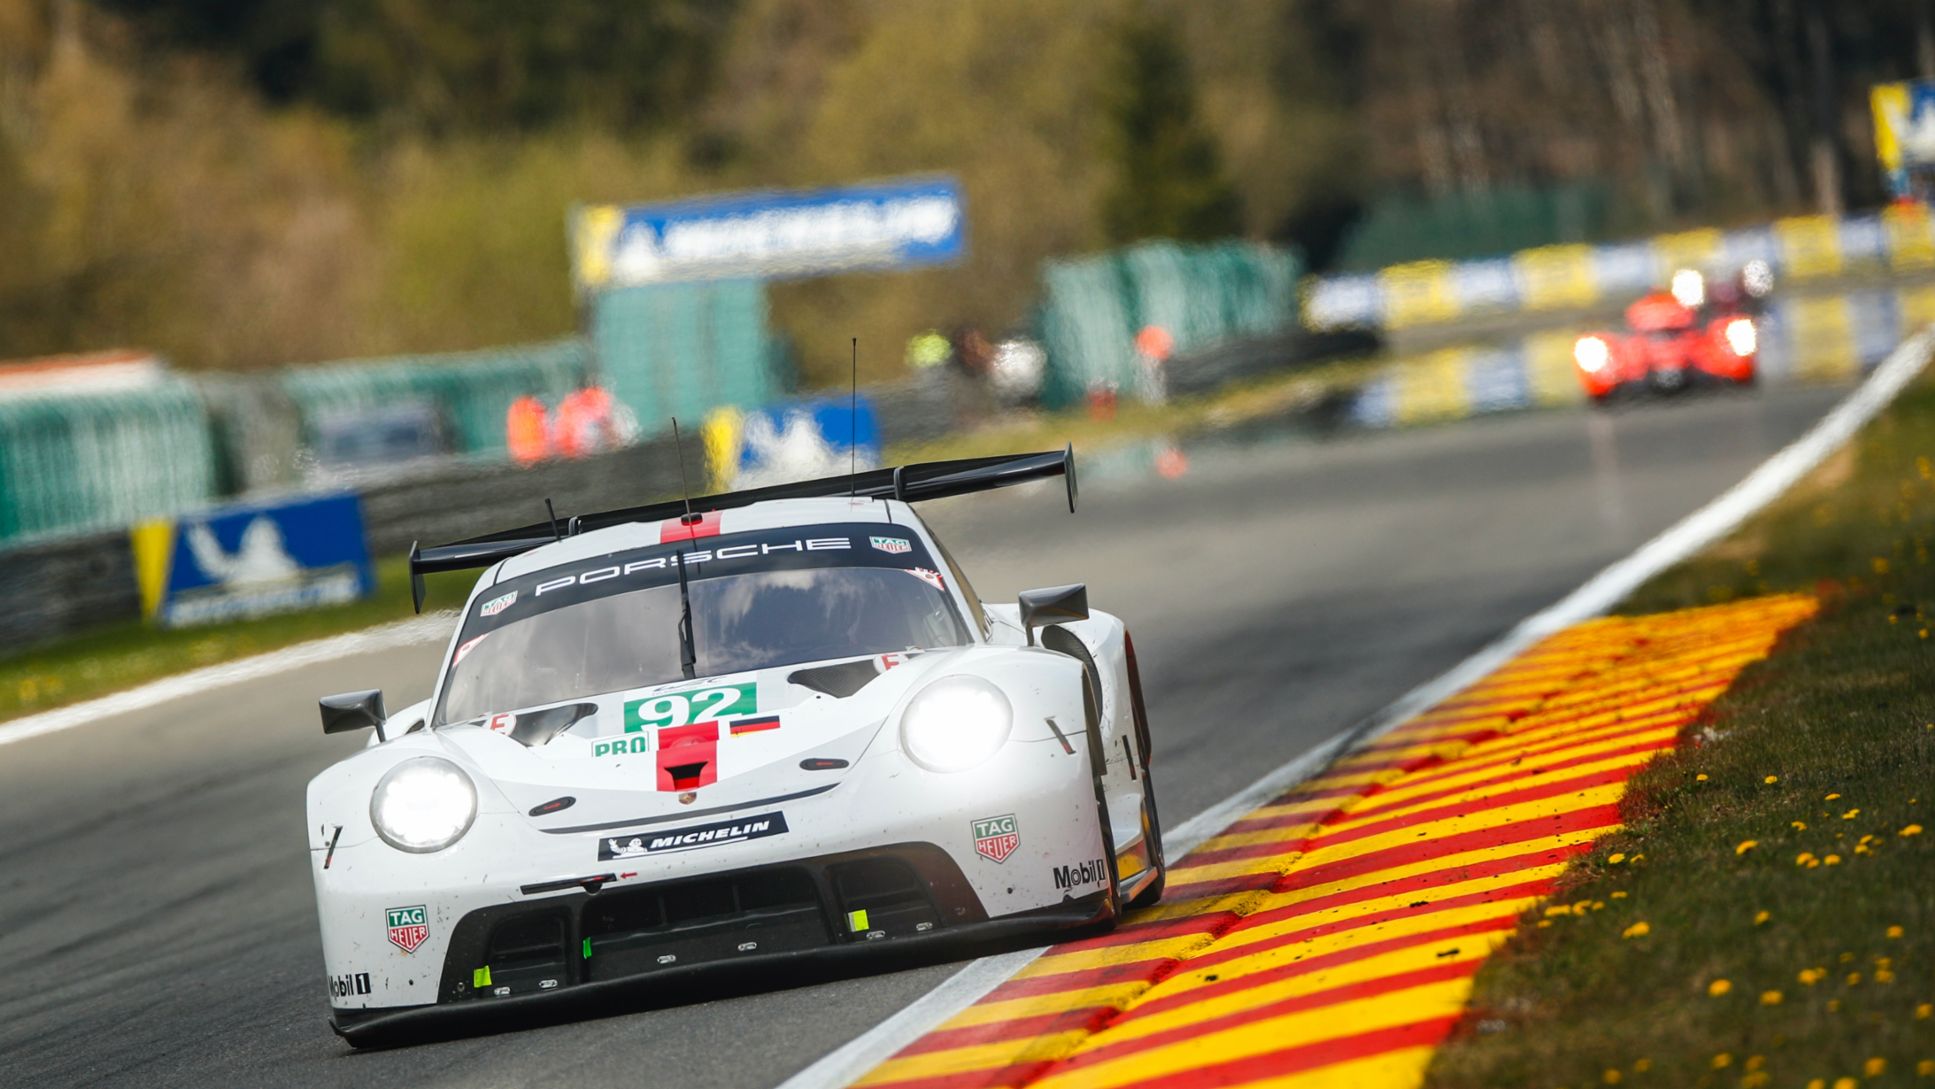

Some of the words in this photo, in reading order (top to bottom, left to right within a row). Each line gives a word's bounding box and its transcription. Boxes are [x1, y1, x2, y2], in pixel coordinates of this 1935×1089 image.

[535, 537, 851, 597] PORSCHE
[638, 688, 743, 732] 92
[595, 735, 647, 757] PRO
[650, 820, 770, 849] MICHELIN
[976, 819, 1013, 836] TAG
[977, 836, 1017, 858] HEUER
[1053, 859, 1096, 889] Mobil
[390, 910, 423, 925] TAG
[390, 927, 426, 949] HEUER
[356, 974, 369, 994] 1
